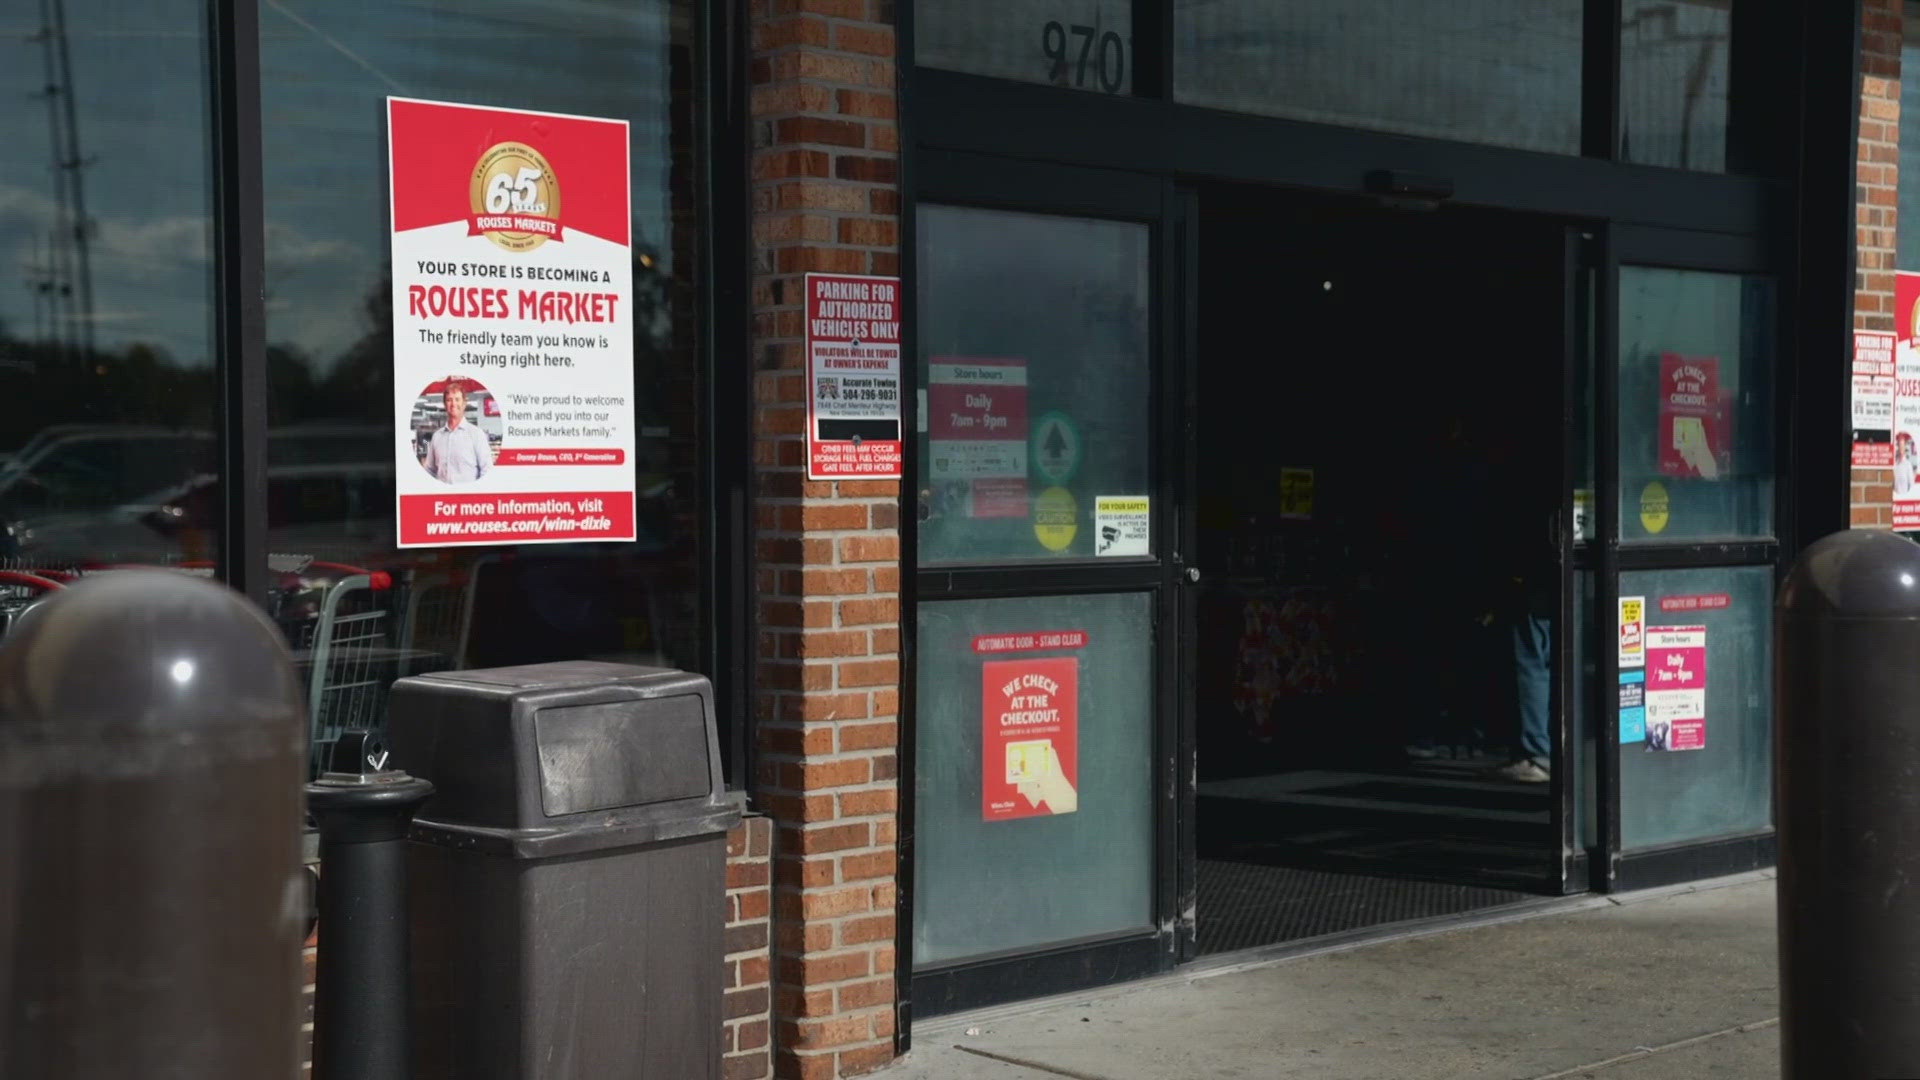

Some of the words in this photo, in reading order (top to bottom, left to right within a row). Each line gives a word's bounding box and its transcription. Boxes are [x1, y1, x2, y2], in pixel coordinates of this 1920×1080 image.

[486, 167, 542, 214] 65
[477, 216, 512, 230] ROUSES
[514, 217, 557, 234] MARKETS
[417, 261, 457, 276] YOUR
[461, 263, 507, 278] STORE
[511, 266, 523, 278] IS
[527, 267, 598, 283] BECOMING
[602, 271, 611, 283] A
[816, 281, 869, 300] PARKING
[872, 284, 894, 302] FOR
[408, 284, 509, 320] ROUSES
[518, 289, 619, 325] MARKET
[818, 300, 892, 320] AUTHORIZED
[812, 318, 868, 338] VEHICLES
[871, 321, 900, 339] ONLY
[418, 329, 443, 344] The
[447, 330, 497, 348] friendly
[501, 332, 533, 346] team
[536, 335, 560, 348] you
[562, 333, 595, 347] know
[599, 335, 609, 348] is
[459, 352, 507, 368] staying
[510, 353, 541, 368] right
[544, 354, 575, 367] here.
[815, 347, 850, 358] VIOLATORS
[850, 347, 866, 358] WILL
[875, 349, 898, 359] TOWED
[824, 359, 833, 368] AT
[862, 360, 889, 370] EXPENSE
[953, 367, 977, 379] Store
[978, 368, 1003, 380] hours
[1684, 365, 1707, 385] CHECK
[842, 377, 872, 388] Accurate
[873, 378, 897, 388] Towing
[1677, 382, 1686, 393] AT
[1687, 382, 1700, 393] THE
[542, 395, 571, 406] proud
[573, 396, 583, 405] to
[584, 395, 625, 406] welcome
[965, 393, 992, 411] Daily
[507, 411, 533, 421] them
[535, 411, 553, 421] and
[555, 413, 572, 423] you
[574, 411, 591, 421] into
[594, 413, 609, 422] our
[950, 413, 973, 427] 7am
[983, 414, 1007, 429] 9pm
[508, 427, 542, 437] Rouses
[544, 427, 580, 437] Markets
[582, 426, 616, 438] family."
[434, 501, 457, 516] For
[460, 502, 494, 516] more
[498, 499, 575, 516] information,
[578, 498, 604, 512] visit
[426, 516, 611, 535] www.rouses.com/winn-dixie
[977, 637, 1015, 651] AUTOMATIC
[1016, 636, 1034, 648] DOOR
[1039, 635, 1061, 647] STAND
[1061, 633, 1082, 646] CLEAR
[1661, 635, 1675, 643] Store
[1676, 634, 1690, 643] hours
[1667, 653, 1684, 668] Daily
[1002, 677, 1022, 697] WE
[1022, 674, 1059, 697] CHECK
[1657, 670, 1673, 682] 7am
[1677, 670, 1693, 684] 9pm
[1011, 696, 1025, 710] AT
[1027, 695, 1048, 708] THE
[1001, 709, 1060, 726] CHECKOUT.
